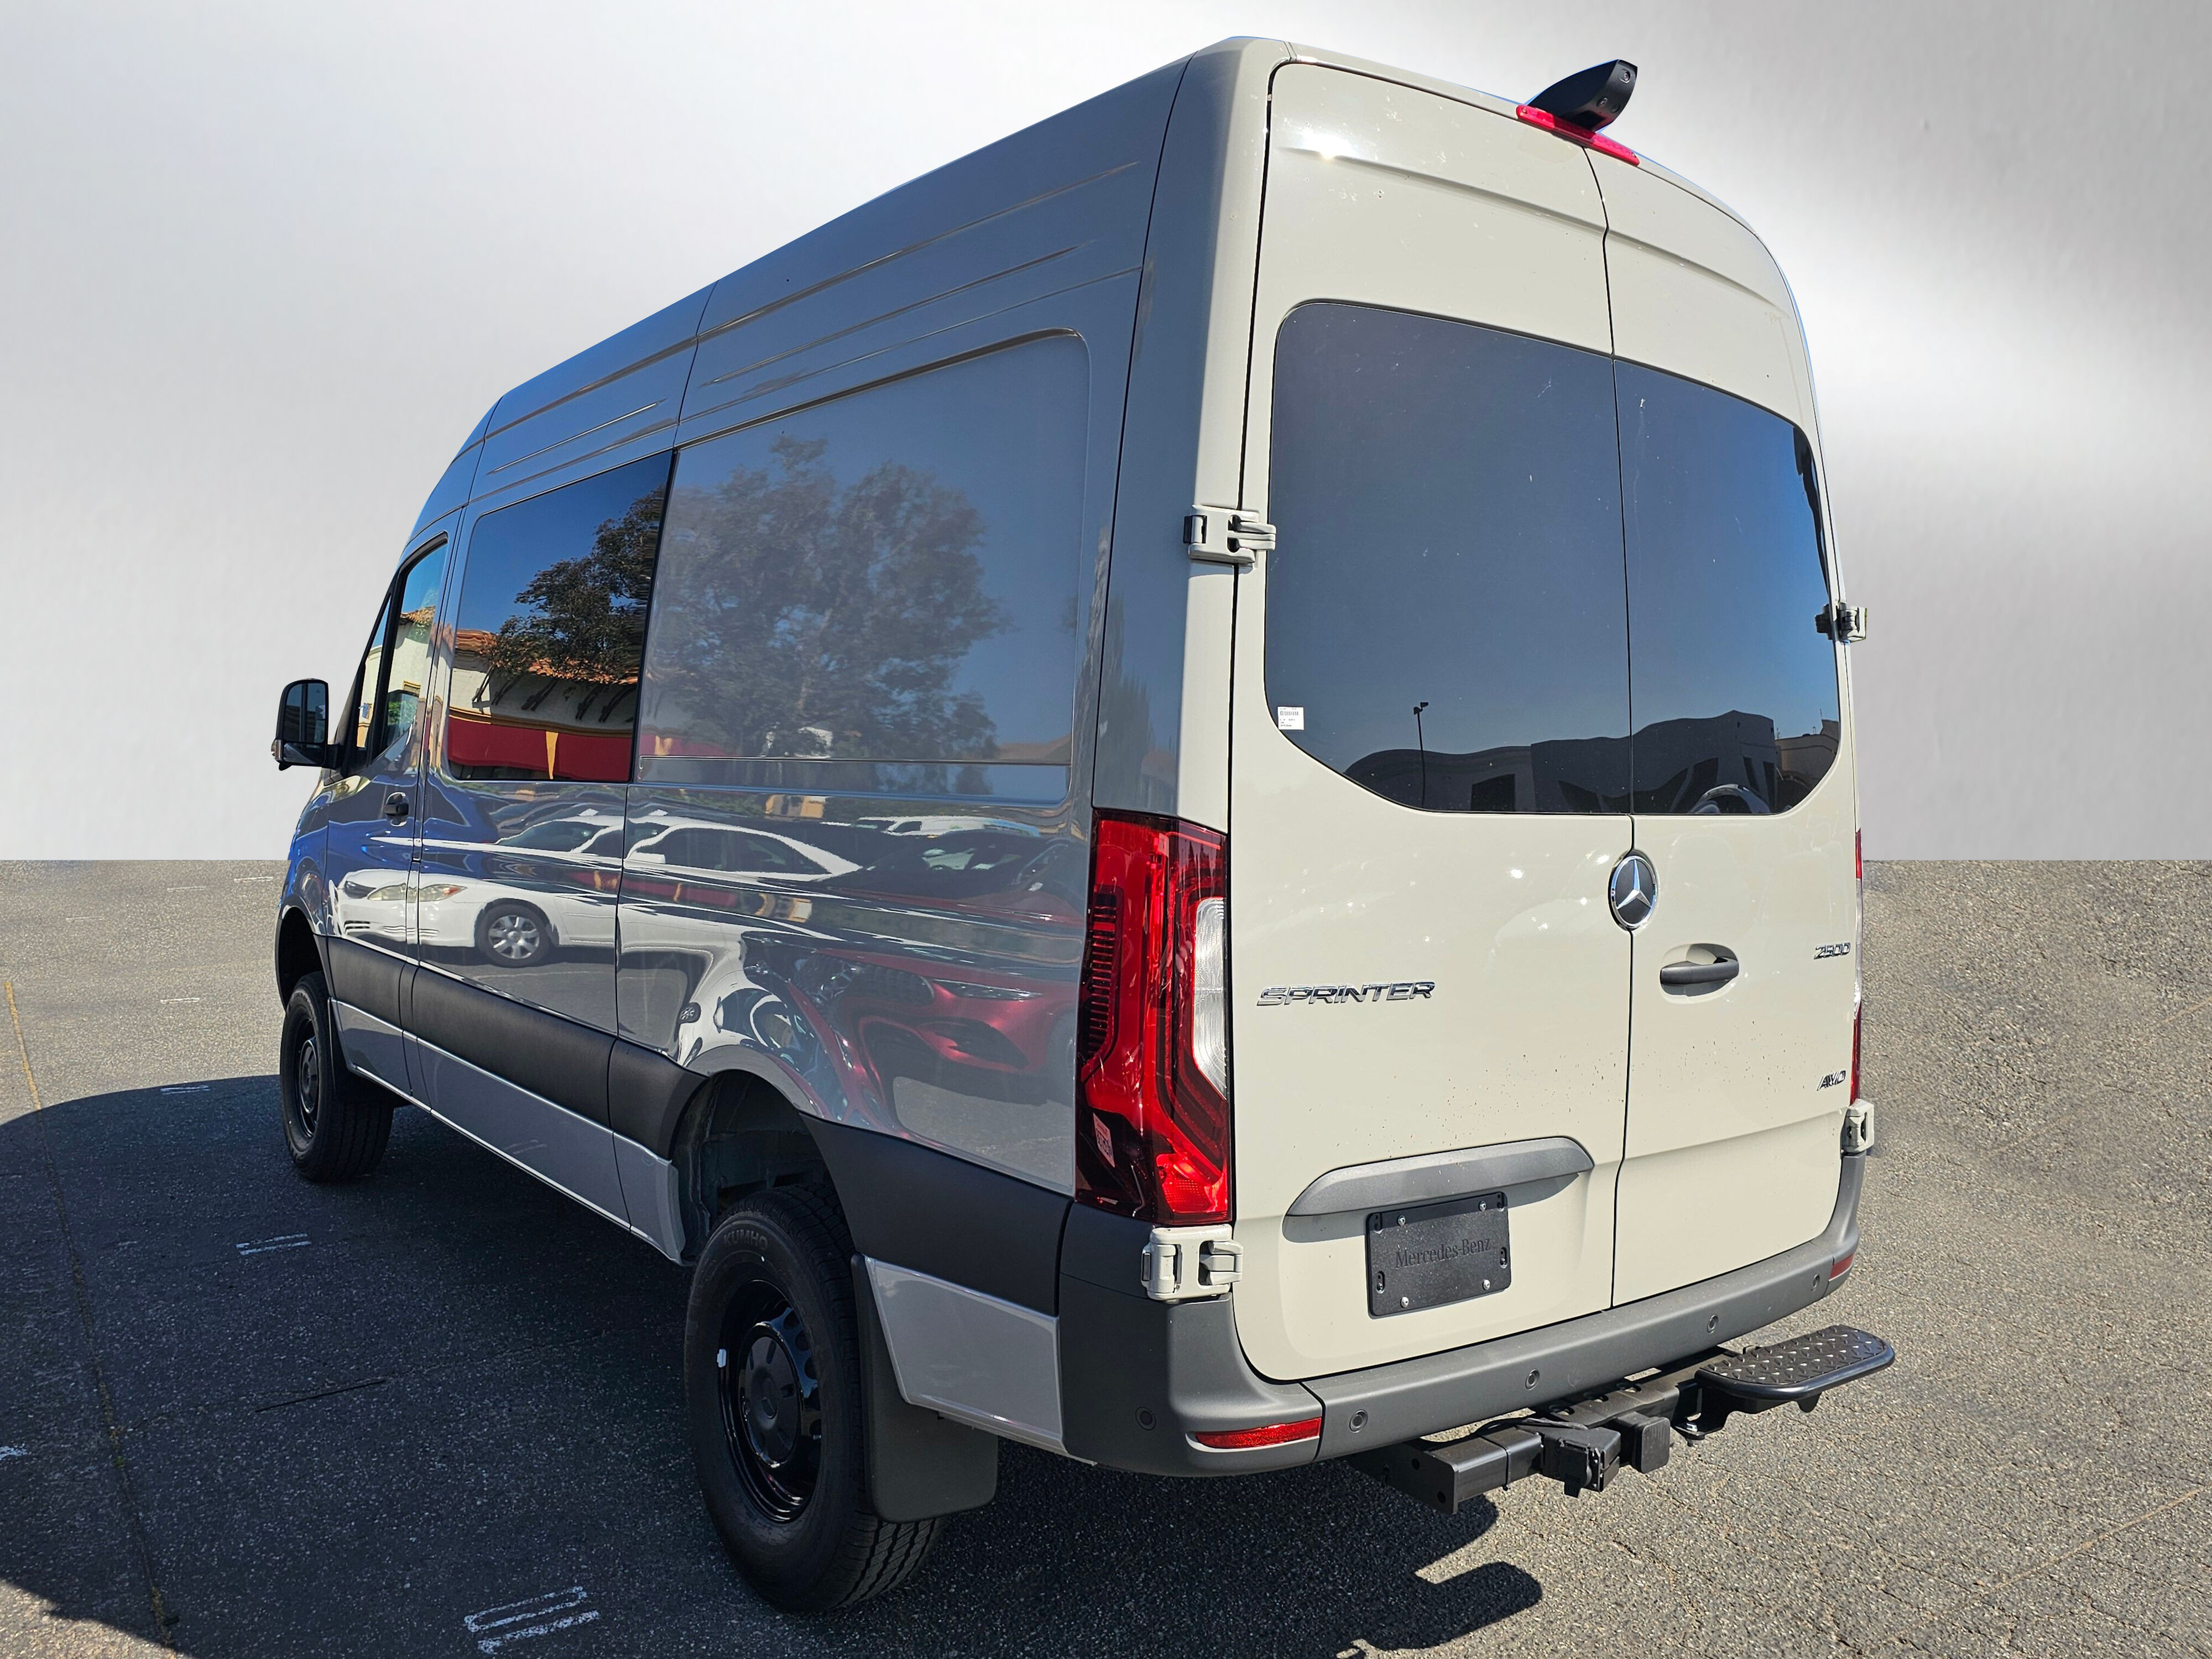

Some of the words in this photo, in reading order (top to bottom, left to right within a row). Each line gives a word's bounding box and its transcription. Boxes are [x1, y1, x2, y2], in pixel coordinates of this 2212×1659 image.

[1814, 942, 1851, 959] 2500
[1256, 980, 1436, 1006] SPRINTER
[1817, 1070, 1846, 1091] AWD
[723, 1229, 768, 1251] KUMHO
[1395, 1238, 1491, 1268] Mercedes-Benz
